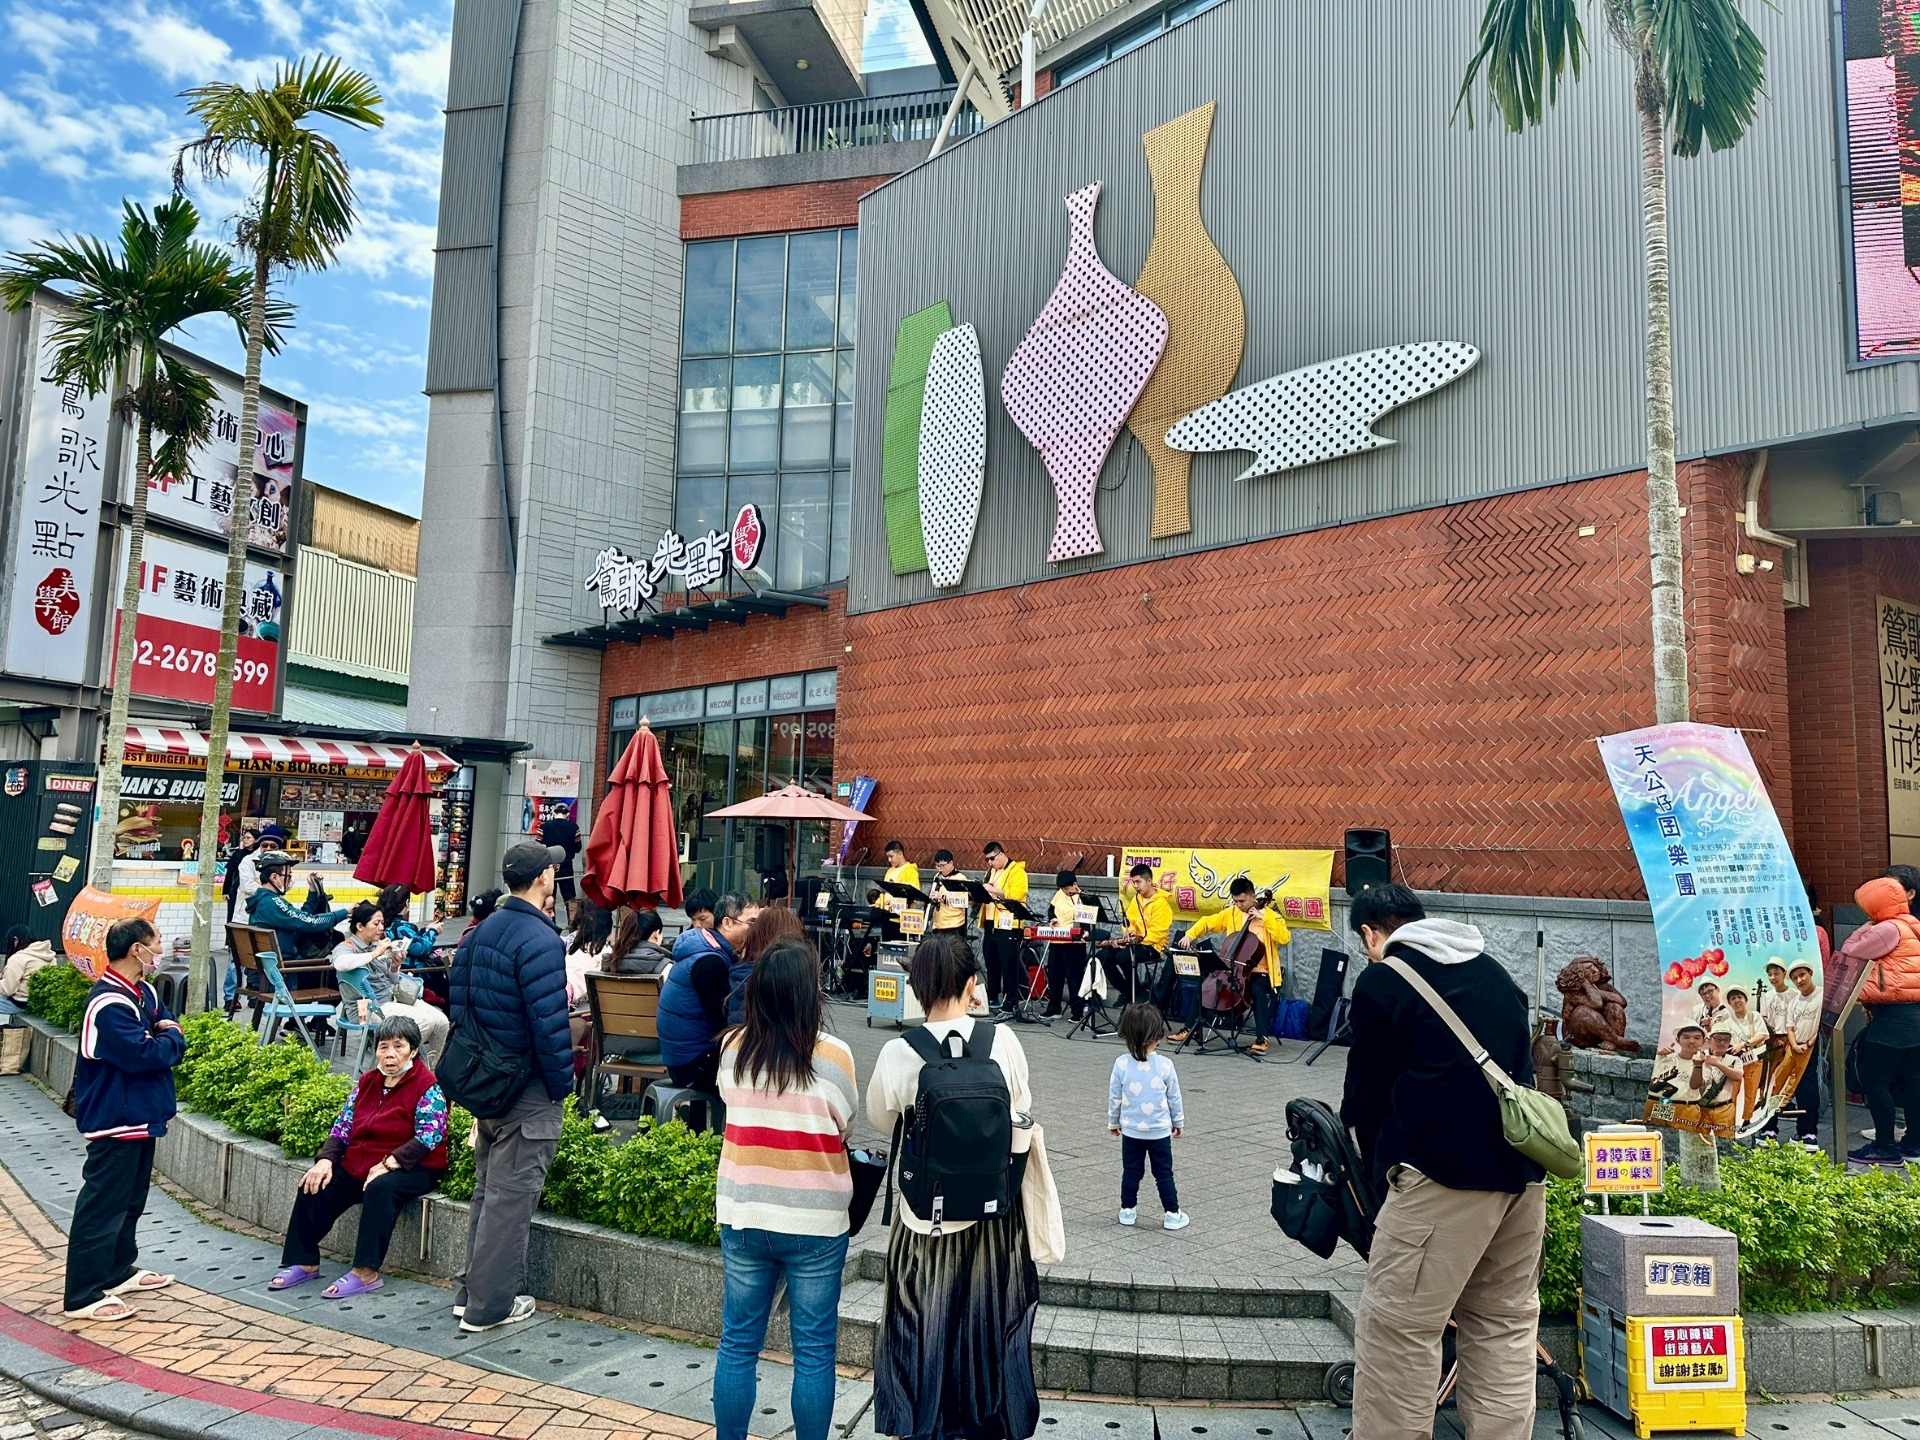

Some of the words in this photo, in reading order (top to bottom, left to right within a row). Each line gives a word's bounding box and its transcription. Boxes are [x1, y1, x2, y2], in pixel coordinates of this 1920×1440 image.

[734, 511, 757, 560] 美學館
[36, 572, 77, 632] 美學館
[132, 637, 270, 686] 2-2678599
[772, 690, 799, 701] WELCOME
[709, 699, 732, 709] WELCOME
[145, 753, 187, 765] BURGER
[188, 756, 199, 766] IN
[287, 760, 347, 777] BURGER
[52, 781, 91, 791] DINER
[119, 776, 169, 797] HAN'S
[168, 779, 239, 800] BURER
[1672, 775, 1760, 823] Angel
[1596, 1147, 1652, 1162] 身障家庭
[1649, 1261, 1712, 1286] 打賞箱
[1663, 1327, 1714, 1342] 身心障礙
[1664, 1342, 1715, 1355] 街頭藝人
[1658, 1362, 1724, 1378] 謝謝鼓勵
